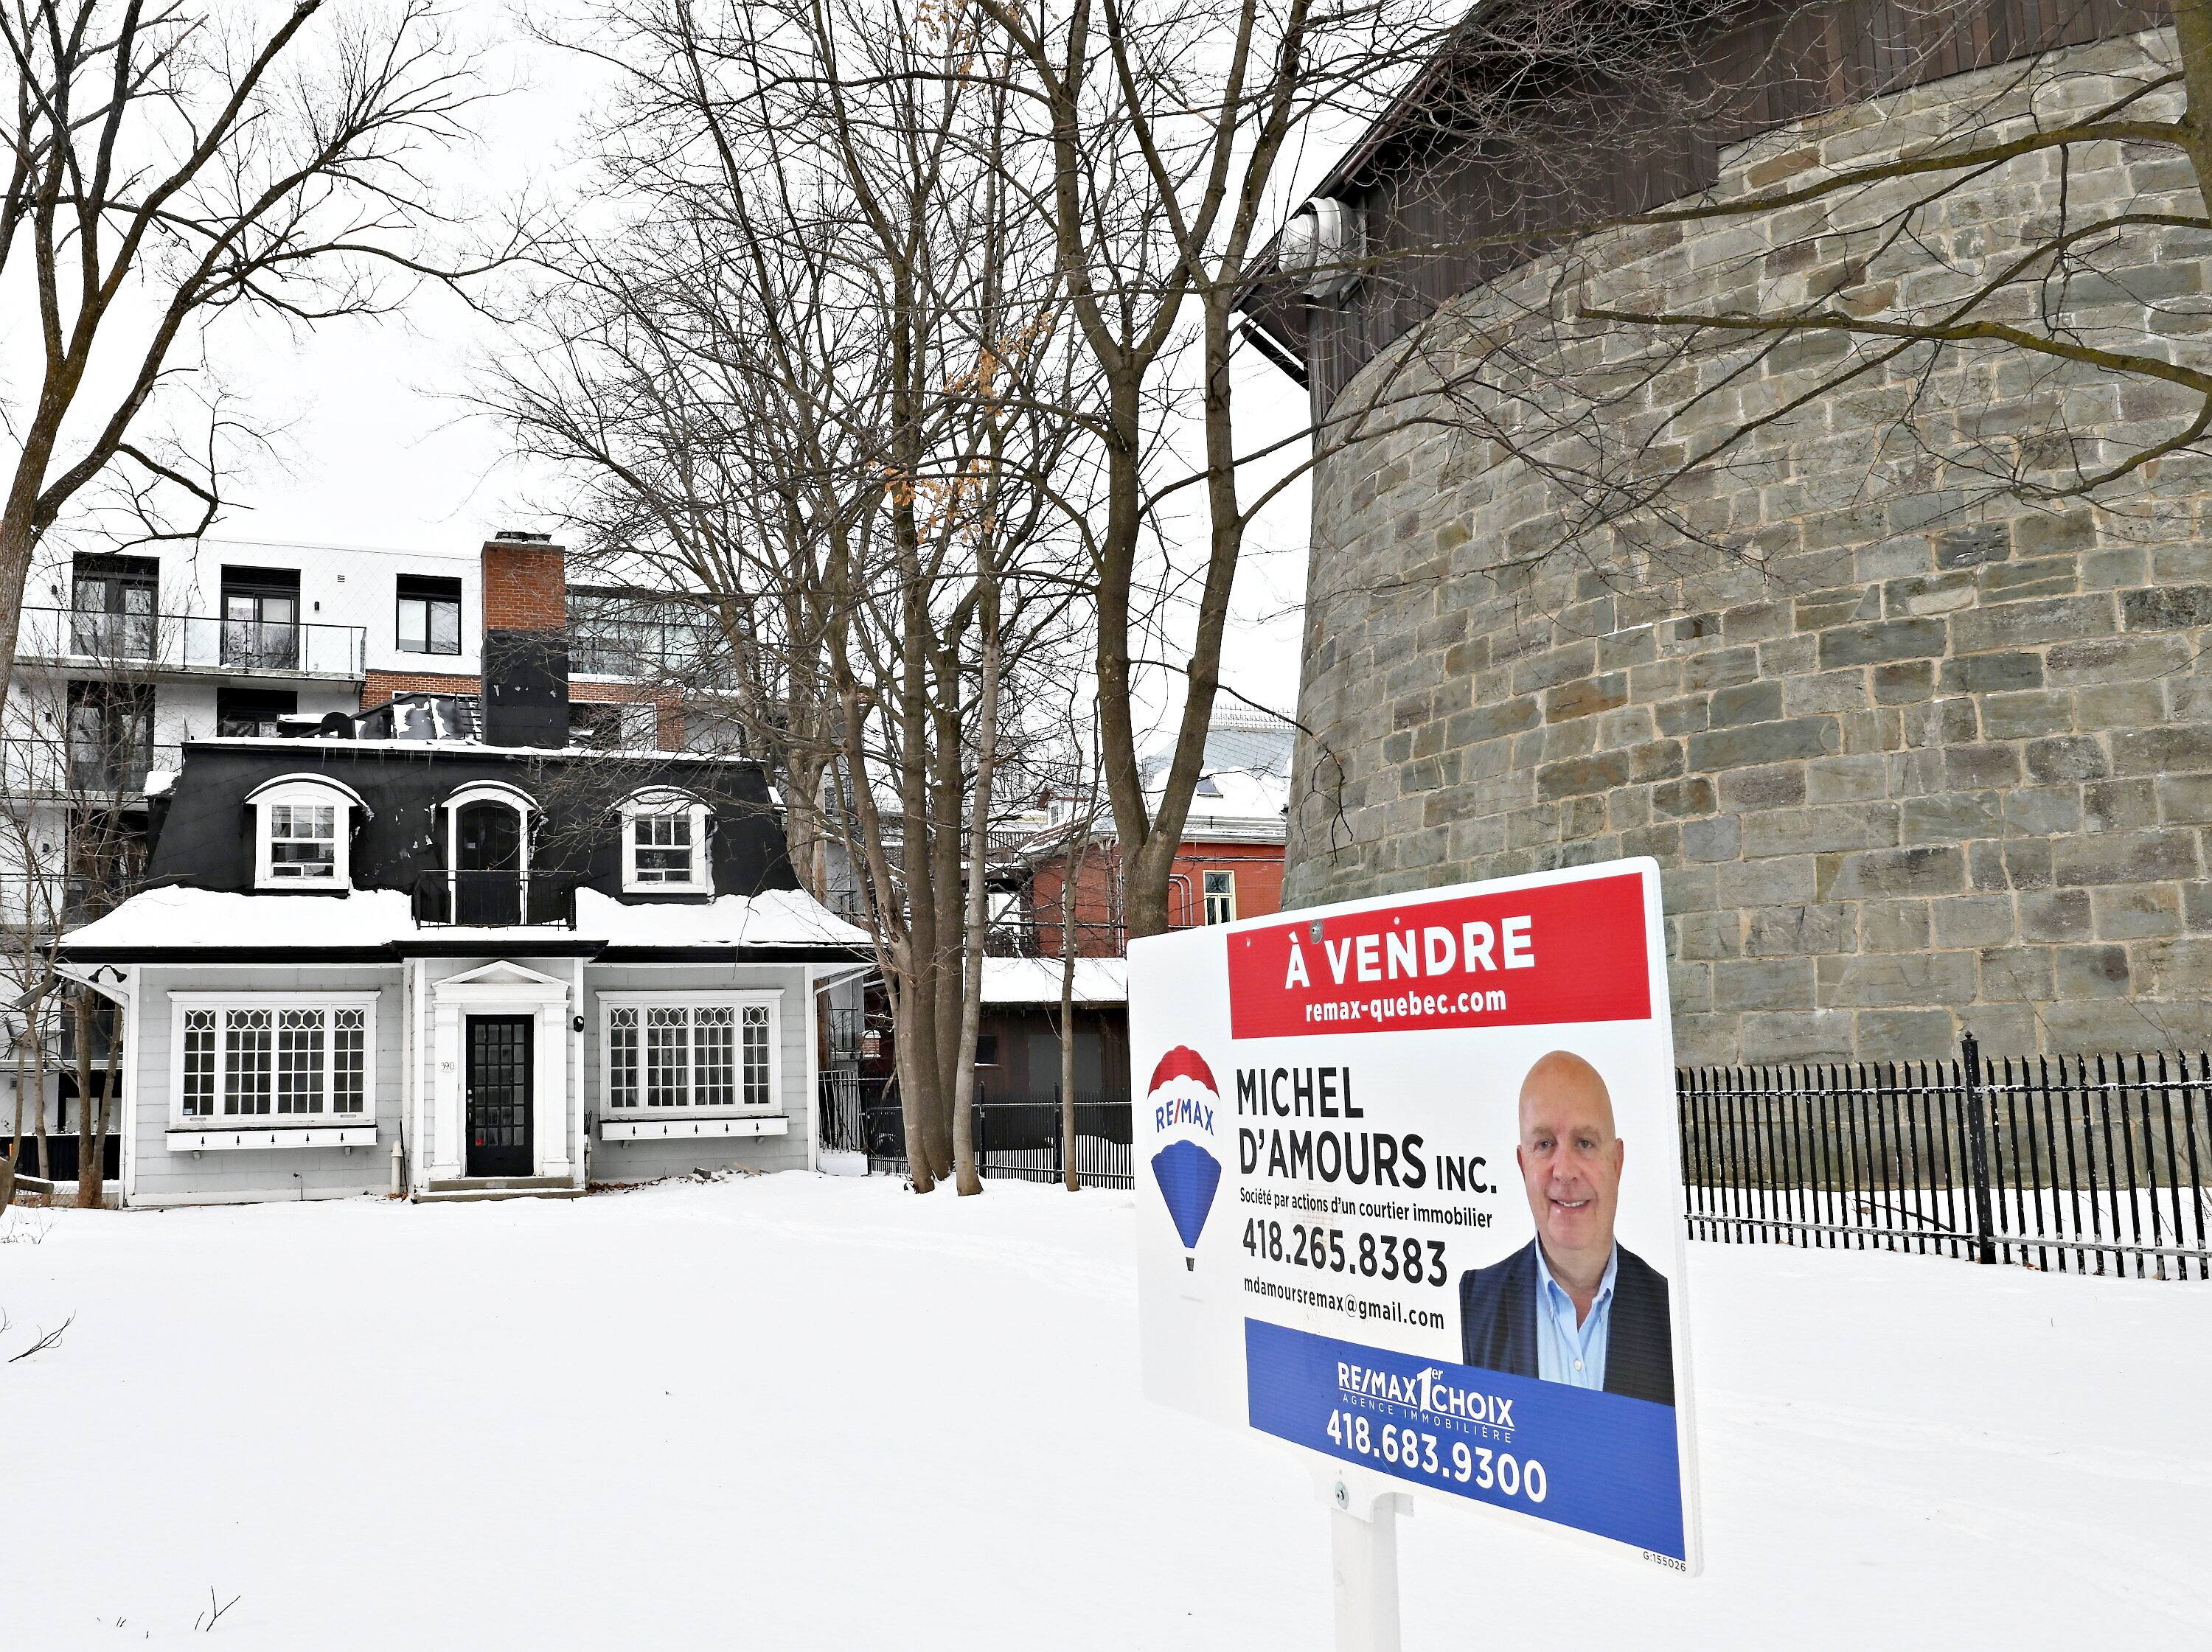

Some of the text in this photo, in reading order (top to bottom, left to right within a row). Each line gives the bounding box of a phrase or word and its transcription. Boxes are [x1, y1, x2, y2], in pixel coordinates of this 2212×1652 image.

[1285, 915, 1535, 989] À VENDRE
[1306, 989, 1506, 1022] remax-quebec.com
[1156, 1098, 1214, 1136] RE/MAX
[1237, 1067, 1363, 1118] MICHEL
[1239, 1127, 1497, 1193] D’AMOURS INC.
[1240, 1187, 1492, 1228] Société par actions d’un courtier immobilier
[1242, 1218, 1447, 1287] 418.265.8383
[1244, 1276, 1444, 1330] mdamoursremax@gmail.com
[1338, 1362, 1418, 1406] RE/MAX
[1431, 1384, 1514, 1428] CHOIX
[1343, 1393, 1512, 1443] AGENCE IMMOBILIÈRE
[1326, 1409, 1547, 1503] 418.683.9300
[1644, 1551, 1686, 1572] G:155026
